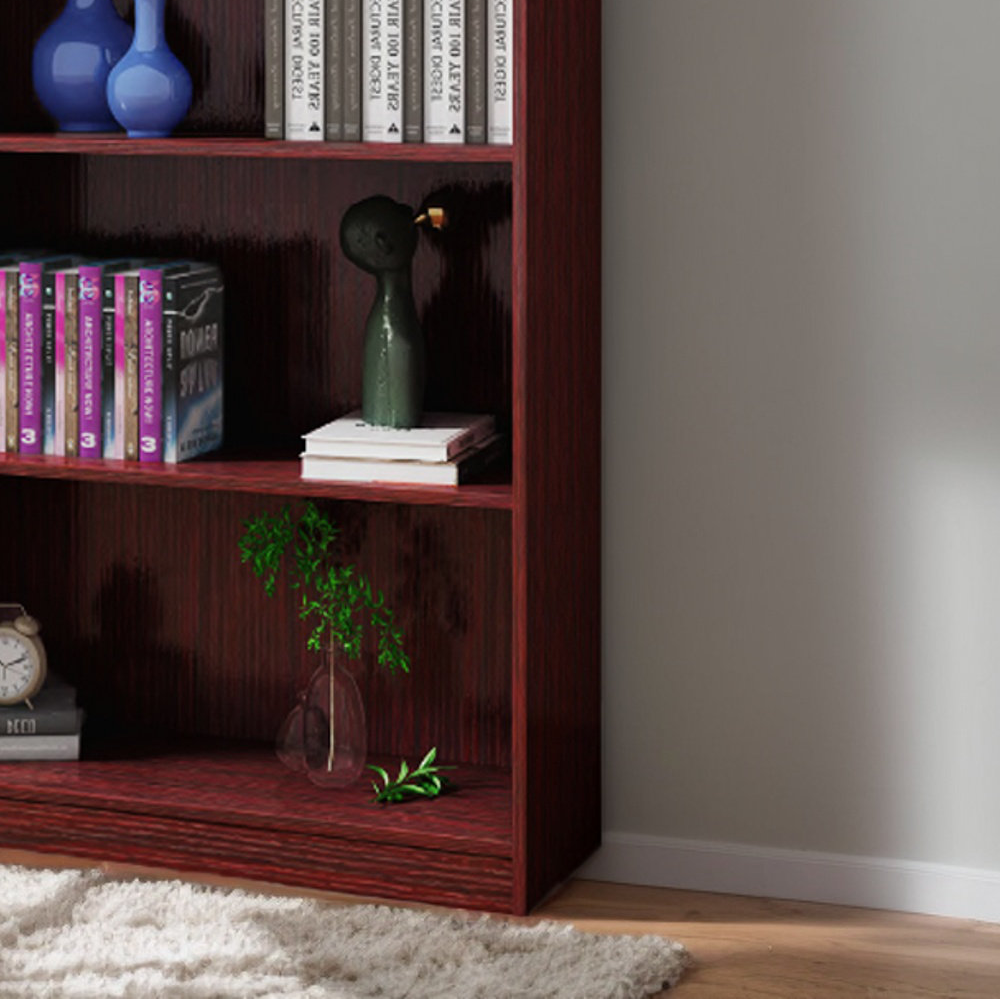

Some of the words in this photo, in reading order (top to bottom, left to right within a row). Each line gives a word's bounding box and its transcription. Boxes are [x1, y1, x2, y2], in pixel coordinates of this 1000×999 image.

[20, 428, 36, 444] 3
[80, 432, 96, 448] 3
[141, 436, 156, 452] 3
